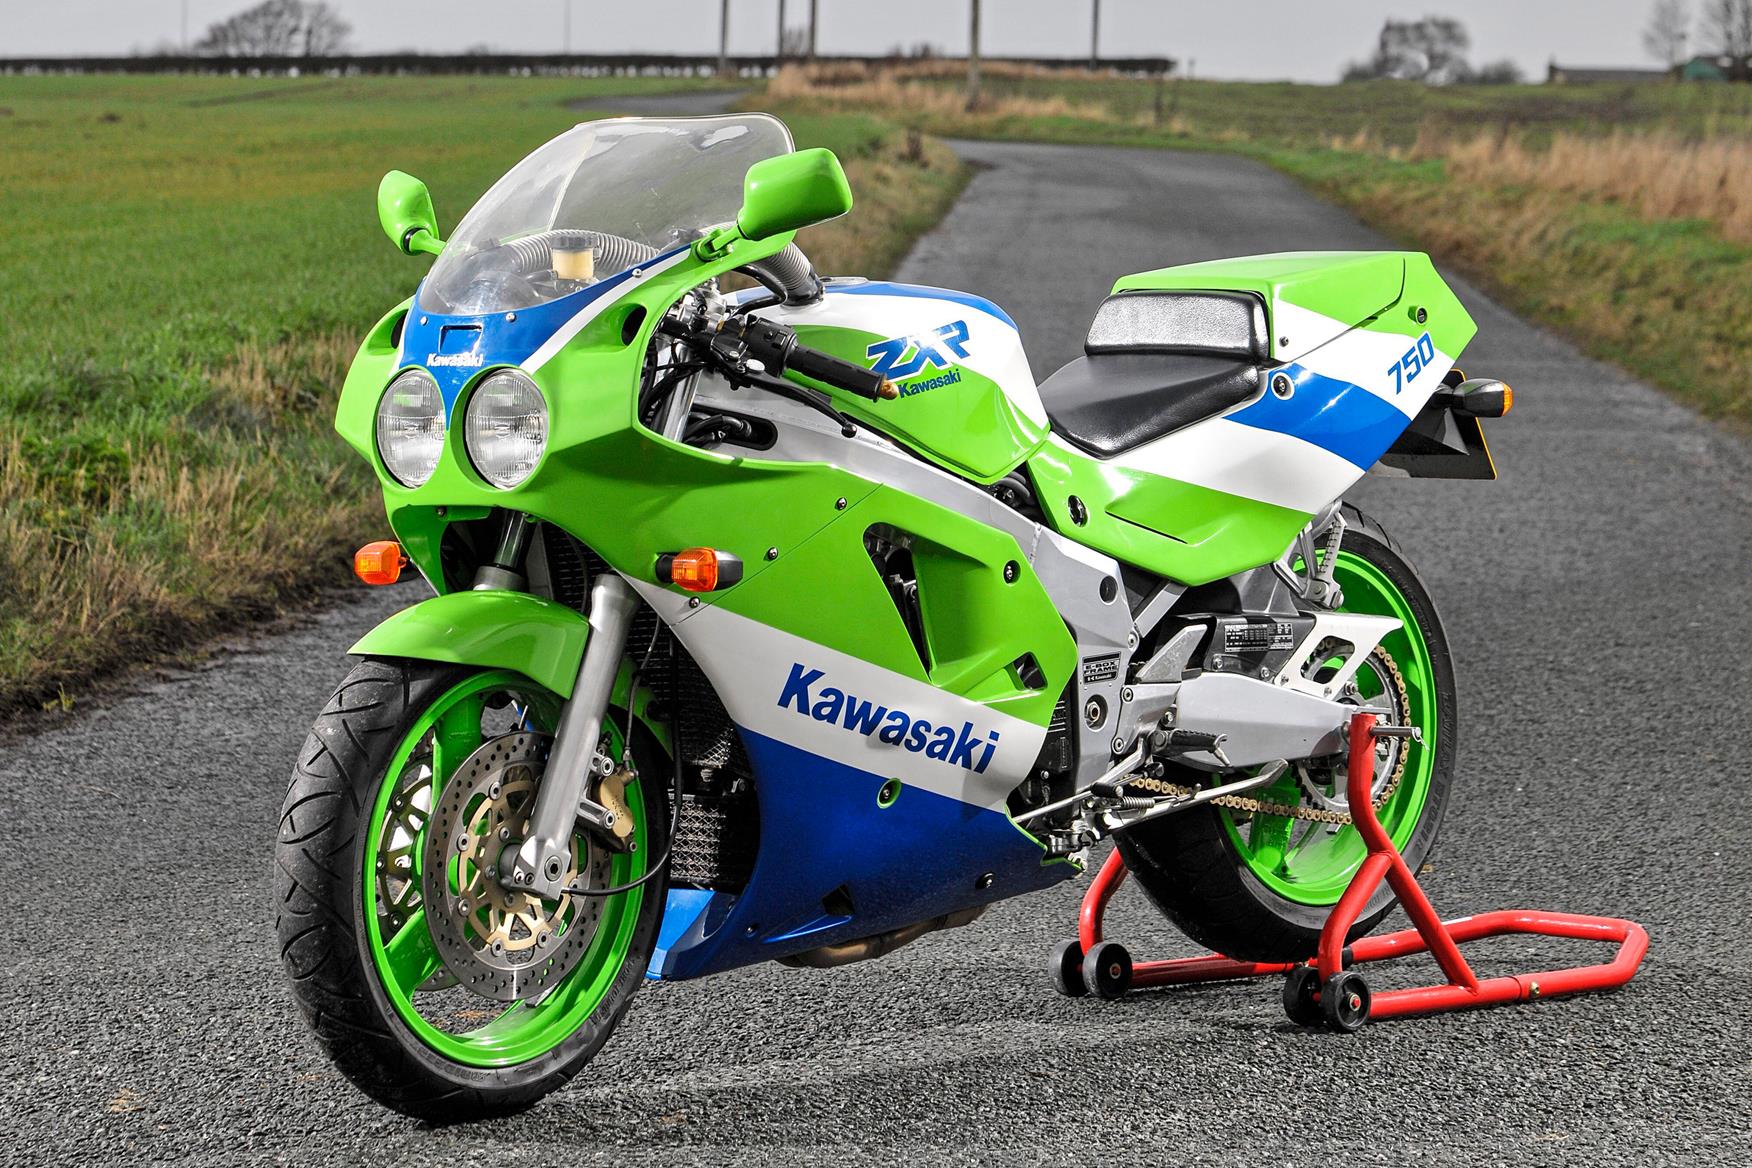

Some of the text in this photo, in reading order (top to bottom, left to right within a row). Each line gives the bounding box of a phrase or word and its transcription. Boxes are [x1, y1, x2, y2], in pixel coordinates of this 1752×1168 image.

[426, 353, 483, 367] Kawasaki
[867, 319, 971, 381] ZXR
[1387, 332, 1435, 395] 750
[898, 368, 962, 399] Kawasaki
[777, 662, 1001, 774] Kawasaki
